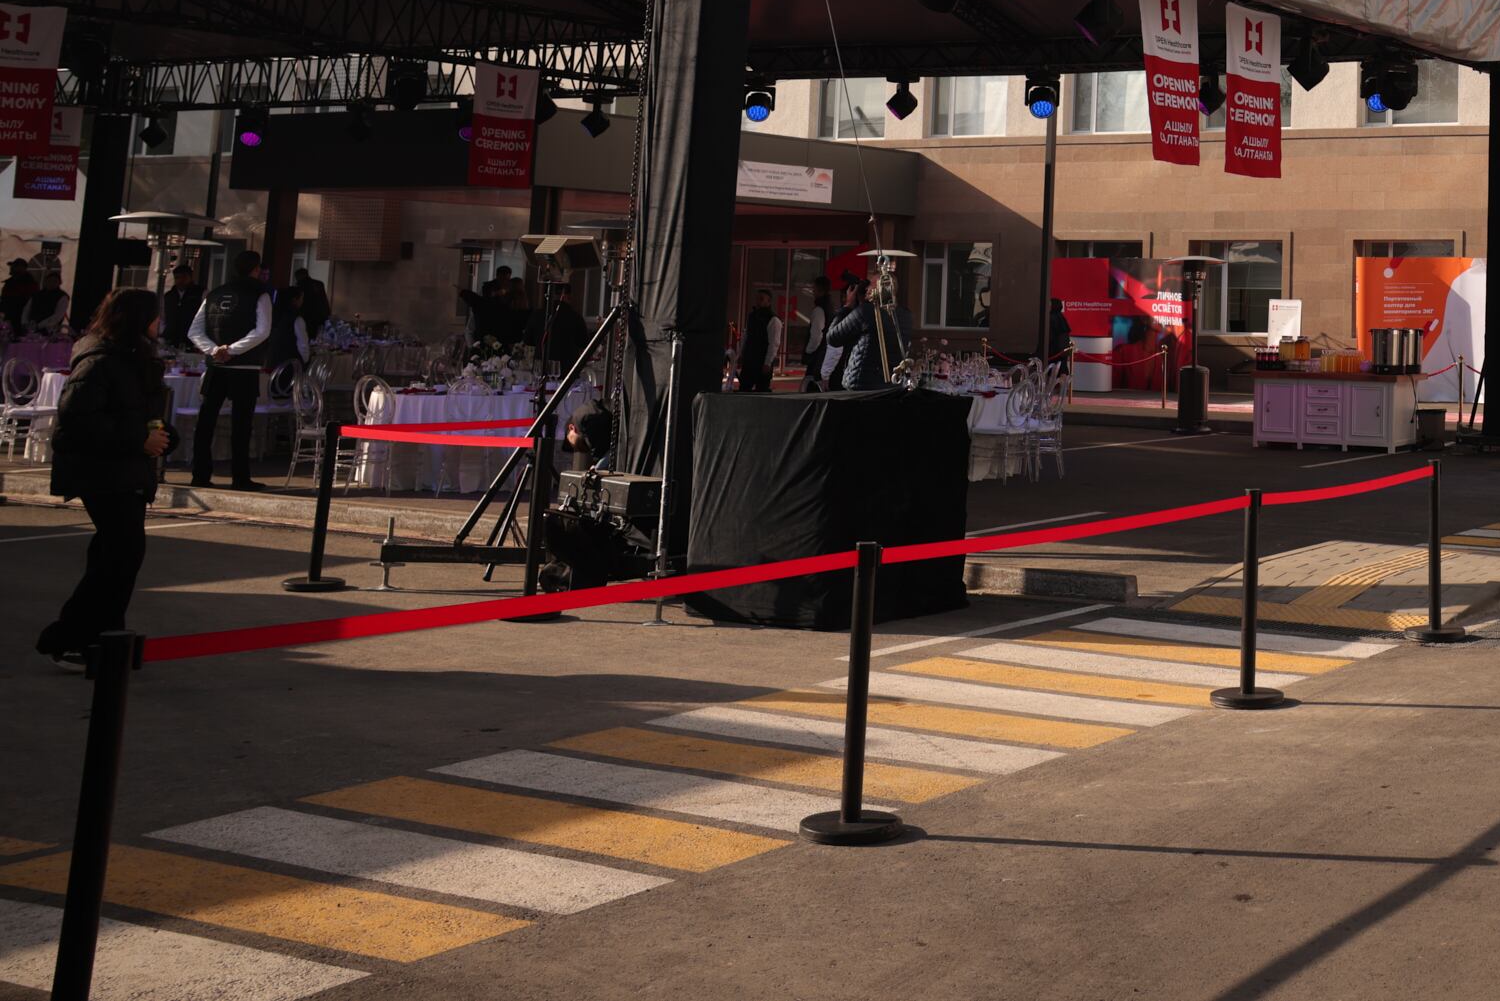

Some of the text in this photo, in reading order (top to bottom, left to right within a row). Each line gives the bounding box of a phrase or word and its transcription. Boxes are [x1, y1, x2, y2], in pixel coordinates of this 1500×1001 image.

[0, 80, 40, 94] NING
[0, 96, 47, 110] MONY
[481, 126, 526, 140] OPENING
[475, 138, 531, 152] CEREMONY
